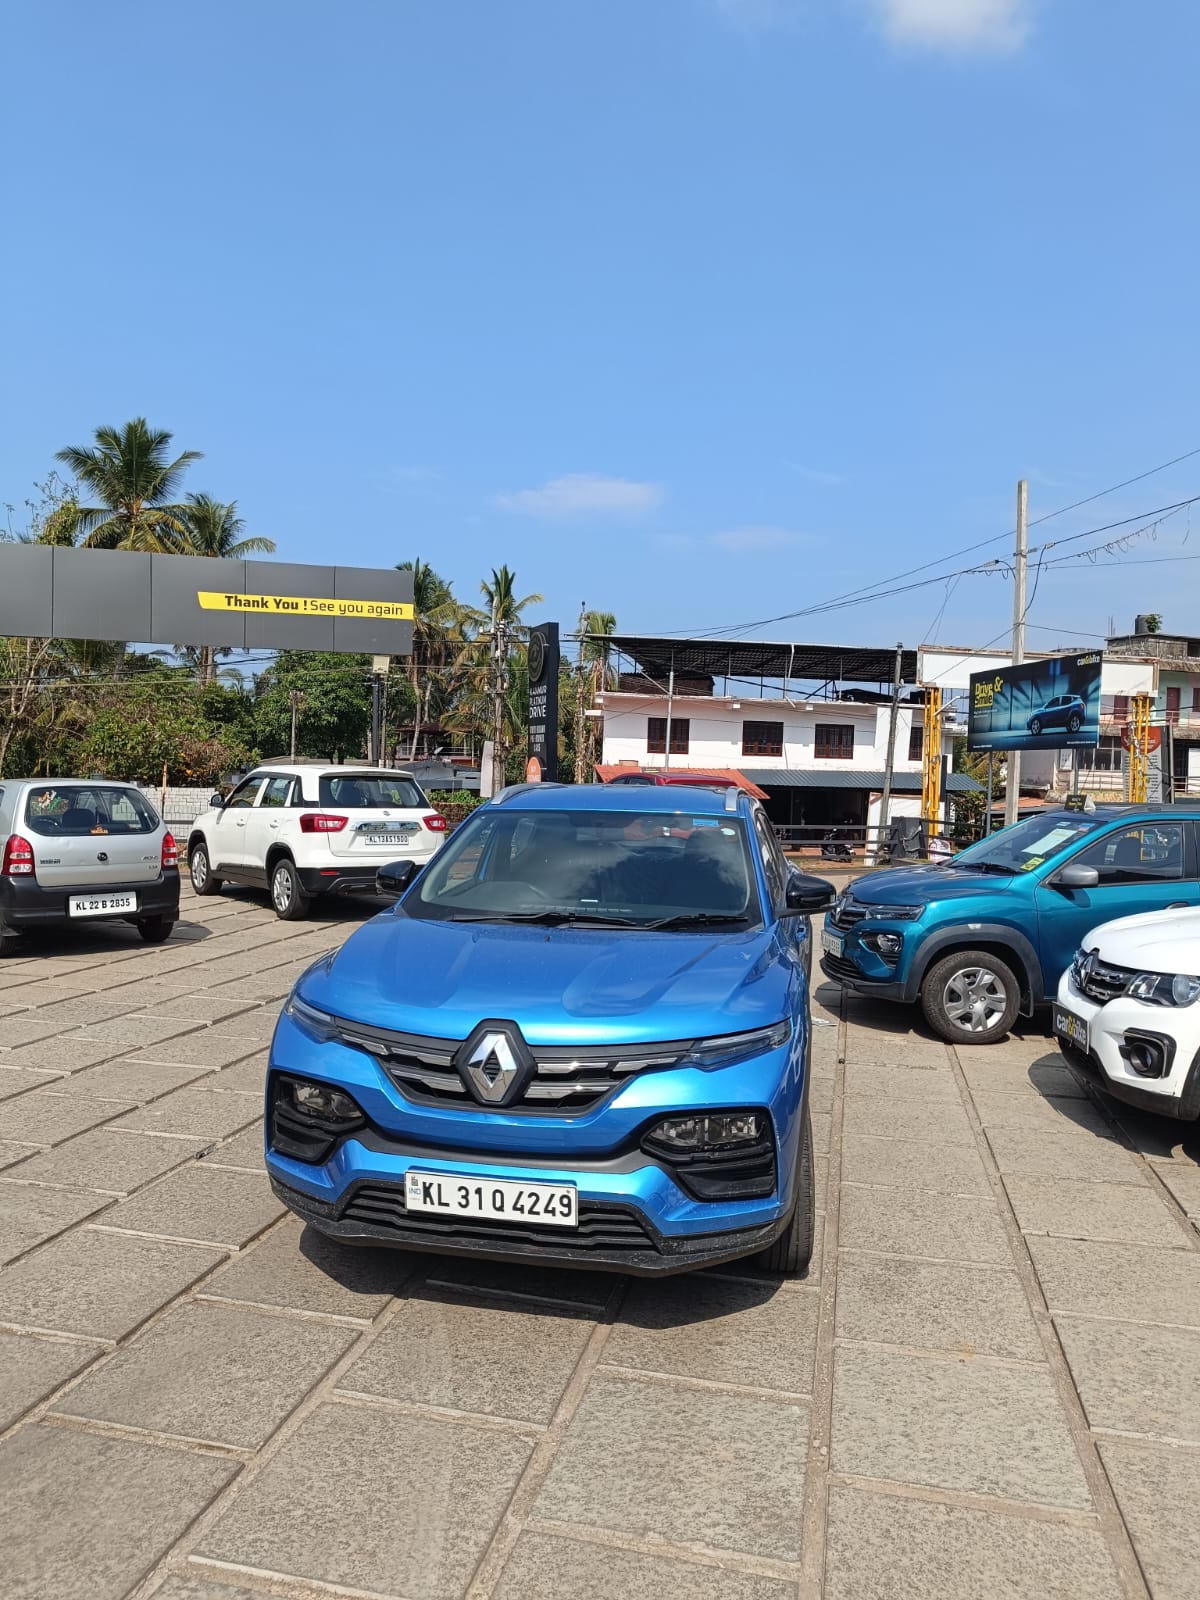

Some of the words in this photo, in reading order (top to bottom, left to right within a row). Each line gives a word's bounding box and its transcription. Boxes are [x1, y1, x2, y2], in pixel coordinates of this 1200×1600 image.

[224, 595, 269, 609] Thank
[273, 598, 299, 610] You
[310, 601, 334, 612] See
[339, 602, 363, 615] you
[367, 603, 404, 616] again
[975, 681, 993, 697] Drive
[529, 705, 547, 718] DRIVE
[76, 902, 87, 911] KL
[89, 901, 99, 910] 22
[102, 900, 107, 909] B
[110, 898, 131, 908] 2835
[423, 1181, 450, 1207] KL
[457, 1186, 483, 1210] 31
[512, 1191, 572, 1218] 4249
